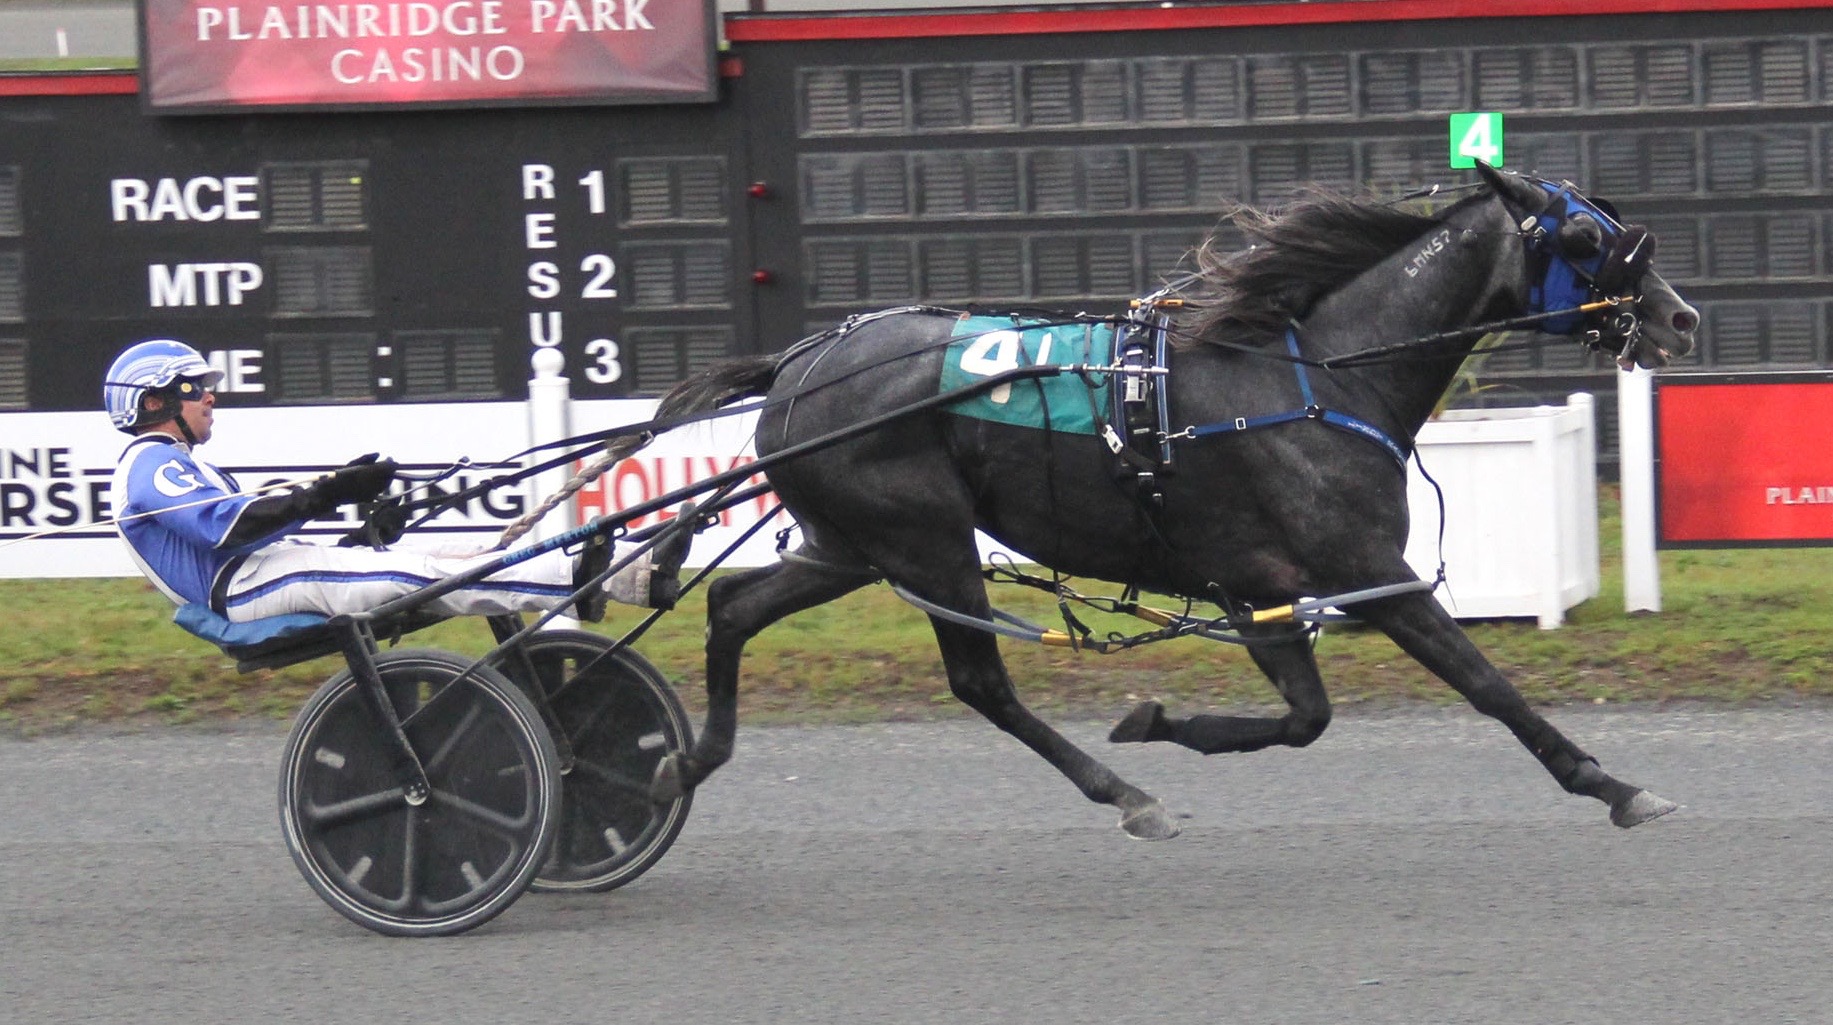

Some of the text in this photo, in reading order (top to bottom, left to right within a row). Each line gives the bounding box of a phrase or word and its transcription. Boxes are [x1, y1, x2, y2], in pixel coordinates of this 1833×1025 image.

[197, 0, 656, 41] PLAINRIDGE PARK
[330, 44, 525, 84] CASINO
[1459, 112, 1498, 165] 4
[110, 176, 261, 222] RACE
[578, 170, 606, 214] 1
[148, 262, 264, 307] MTP
[580, 254, 617, 298] 2
[584, 338, 622, 384] 3
[153, 459, 206, 498] G
[502, 545, 536, 565] GREG
